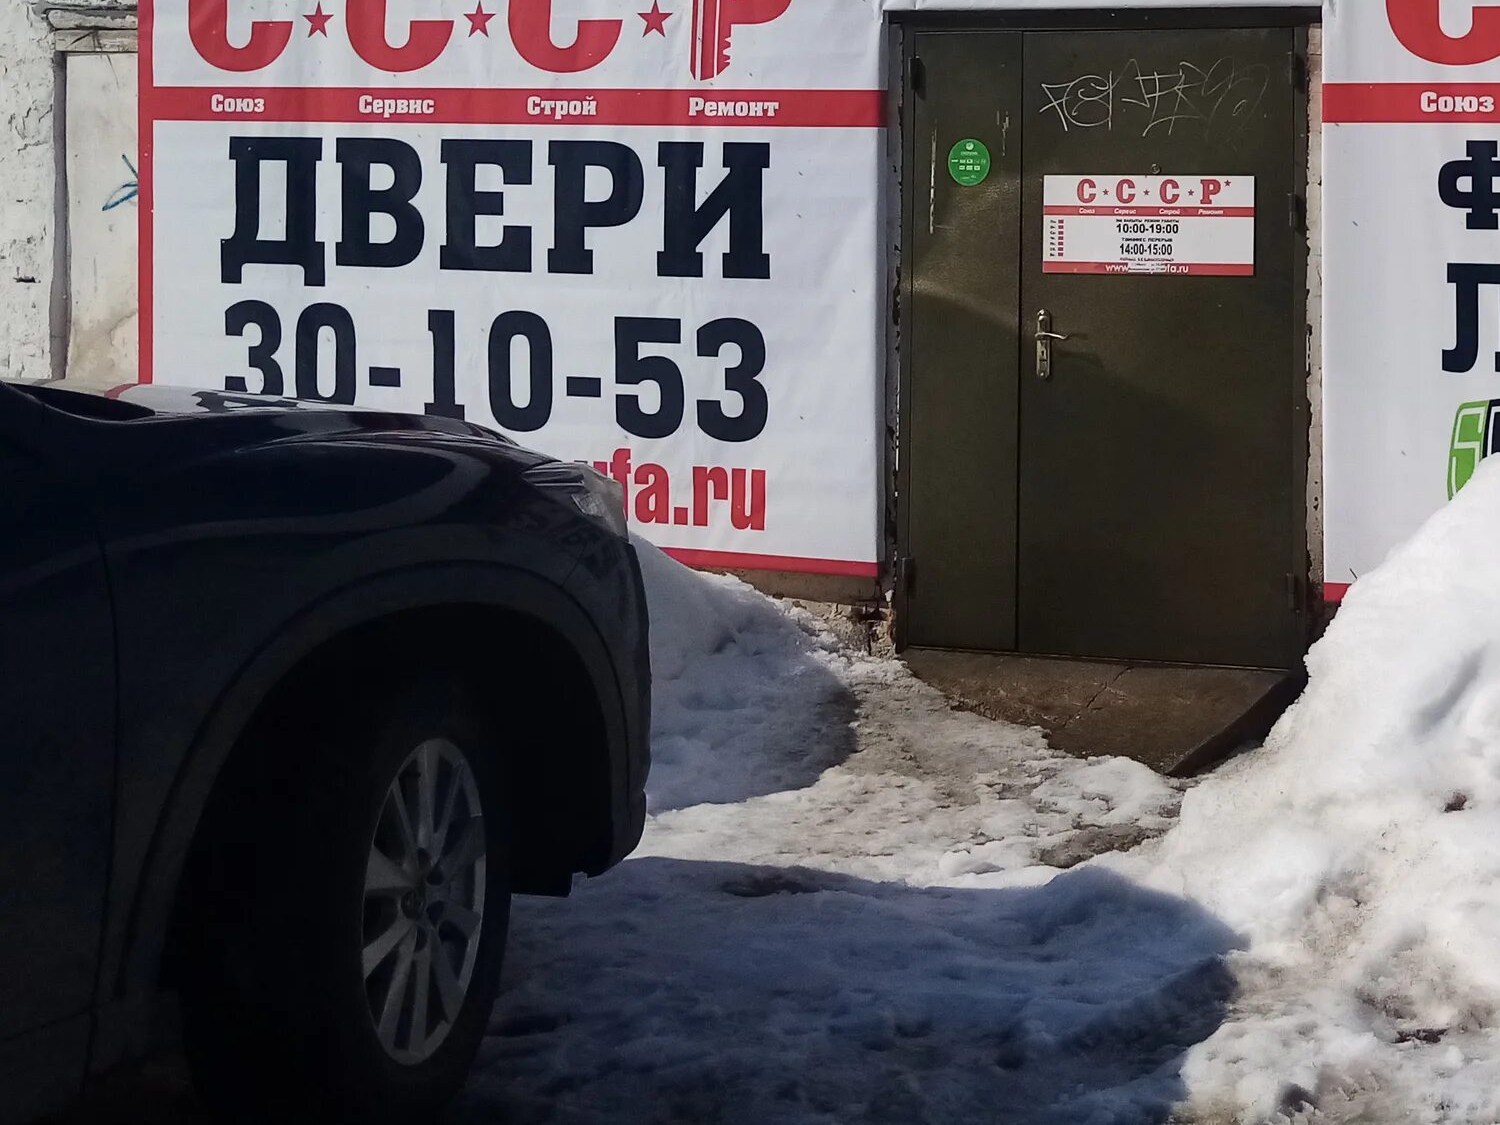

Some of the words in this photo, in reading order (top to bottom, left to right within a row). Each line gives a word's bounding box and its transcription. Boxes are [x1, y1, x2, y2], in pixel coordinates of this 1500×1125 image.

[211, 93, 265, 113] Союз
[358, 94, 435, 118] Сервис
[527, 96, 597, 120] Строй
[688, 97, 779, 117] Ремонт
[1420, 91, 1495, 113] Союз
[220, 136, 771, 287] ДВЕРИ
[1116, 223, 1179, 234] 10:00-19:00
[1119, 243, 1173, 255] 14:00-15:00
[224, 299, 769, 443] 30-10-53
